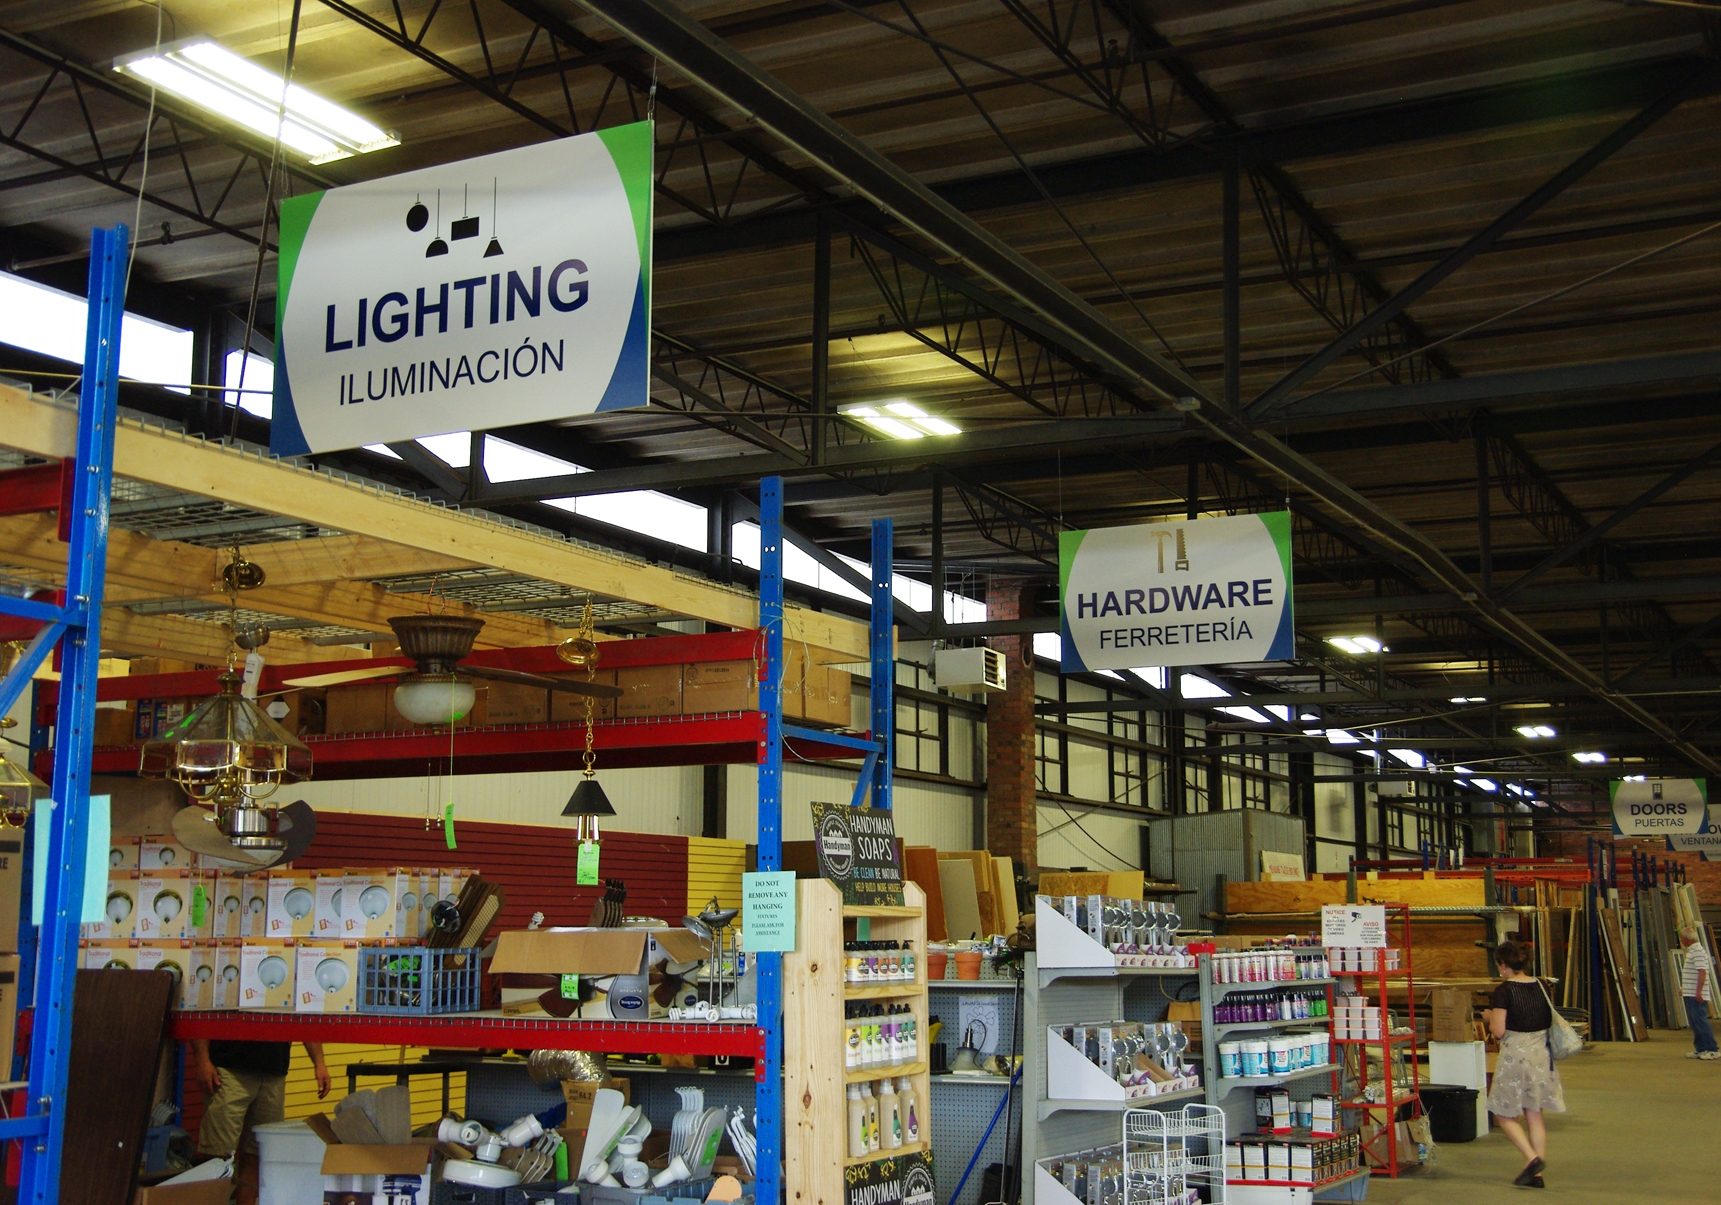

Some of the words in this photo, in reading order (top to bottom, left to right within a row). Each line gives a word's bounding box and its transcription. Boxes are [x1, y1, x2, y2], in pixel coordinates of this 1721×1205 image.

[325, 258, 589, 353] LIGHTING
[339, 337, 565, 405] ILUMINACIÓN
[1078, 578, 1273, 619] HARDWARE
[1100, 617, 1253, 649] FERRETERÍA
[1630, 803, 1687, 816] DOORS
[849, 814, 894, 836] HANDYMAN
[1635, 818, 1685, 828] PUERTAS
[823, 839, 851, 852] Handyman
[857, 837, 893, 861] SOAPS
[748, 891, 774, 899] REMOVE
[774, 891, 789, 899] ANY
[851, 1179, 901, 1205] HANDYMAN
